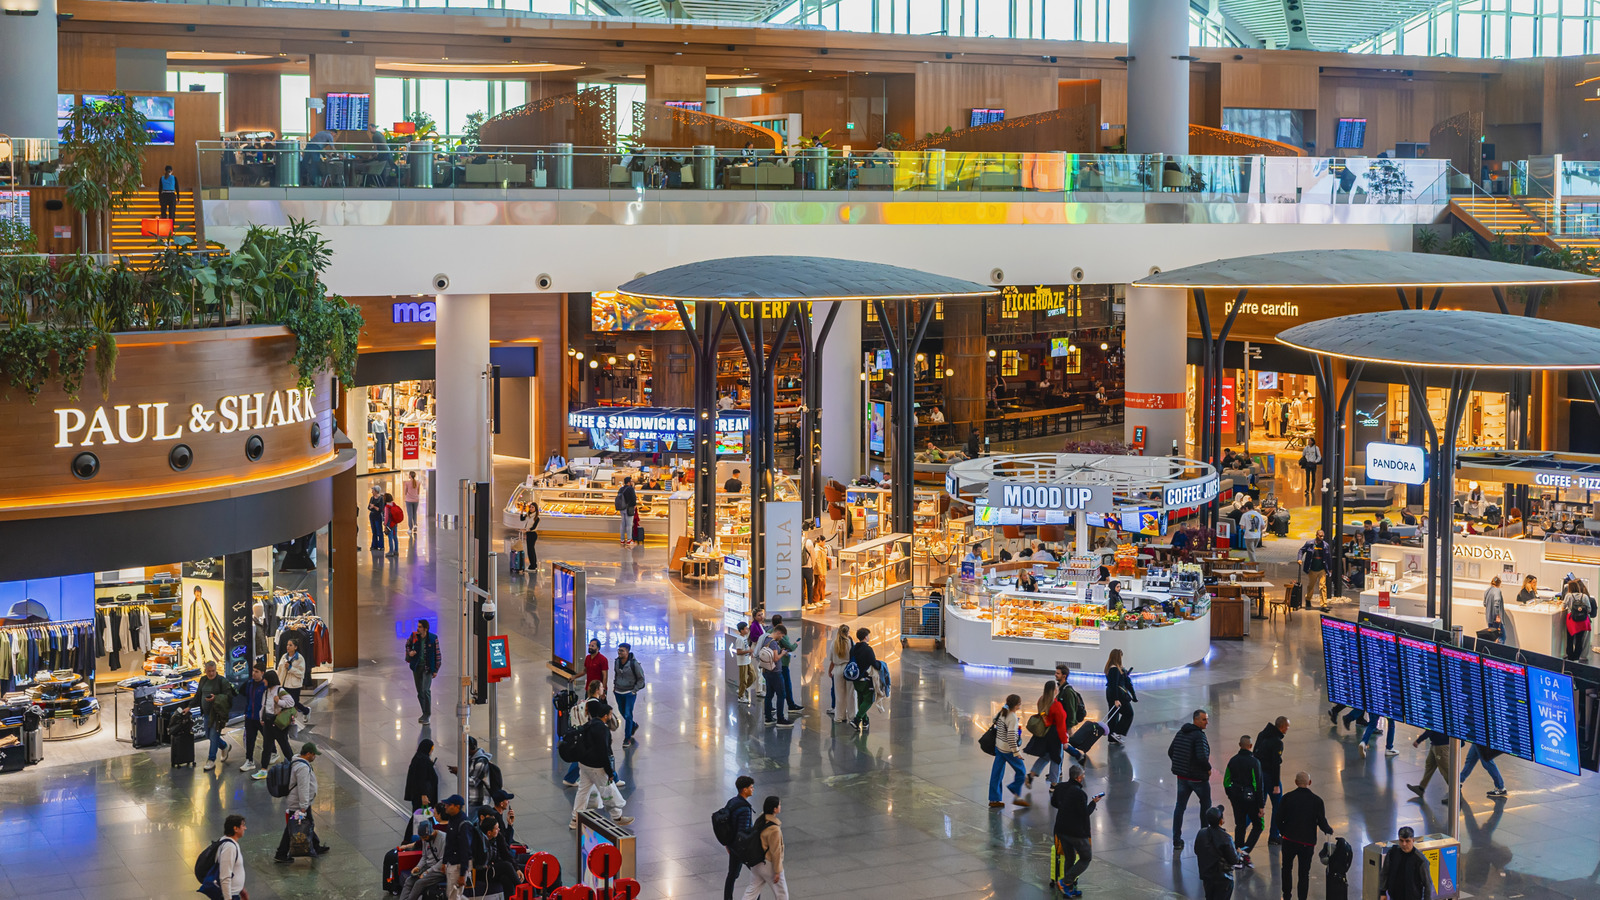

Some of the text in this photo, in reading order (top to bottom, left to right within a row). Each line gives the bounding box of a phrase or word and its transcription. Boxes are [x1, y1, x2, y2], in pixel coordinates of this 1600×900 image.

[1005, 291, 1065, 311] TICKERDAZE
[1225, 299, 1299, 316] prre cardin
[54, 387, 317, 448] PAUL & SHARK
[597, 416, 607, 429] &
[609, 416, 675, 431] SANDWICH
[677, 418, 688, 431] &
[1535, 473, 1571, 487] COFFEE
[1003, 485, 1093, 510] MOOD UP
[1167, 484, 1201, 505] COFFEE
[776, 518, 792, 596] FURLA
[1538, 704, 1567, 723] Wi-Fi
[1540, 743, 1571, 758] Connect Now
